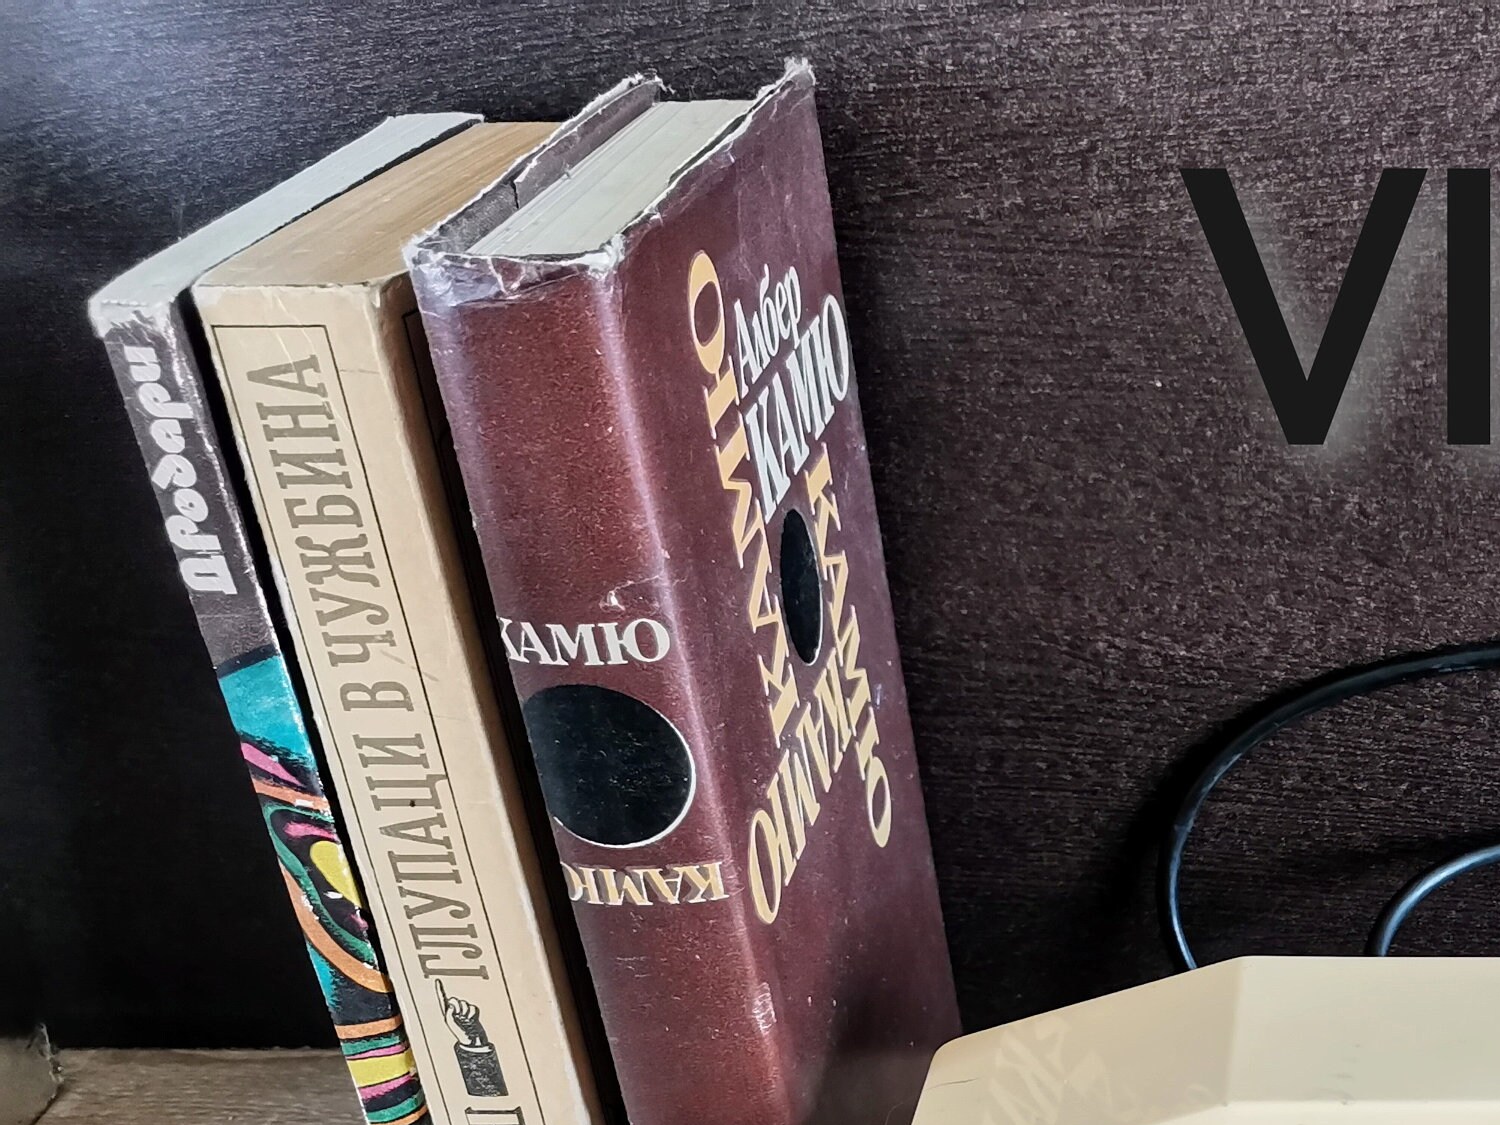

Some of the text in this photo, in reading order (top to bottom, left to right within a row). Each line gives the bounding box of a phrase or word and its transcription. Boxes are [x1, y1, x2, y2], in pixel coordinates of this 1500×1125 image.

[734, 263, 801, 399] Албер
[745, 294, 849, 524] КАМЮ
[246, 354, 489, 980] ГЛУПАЦИ В ЧУЖБИНА
